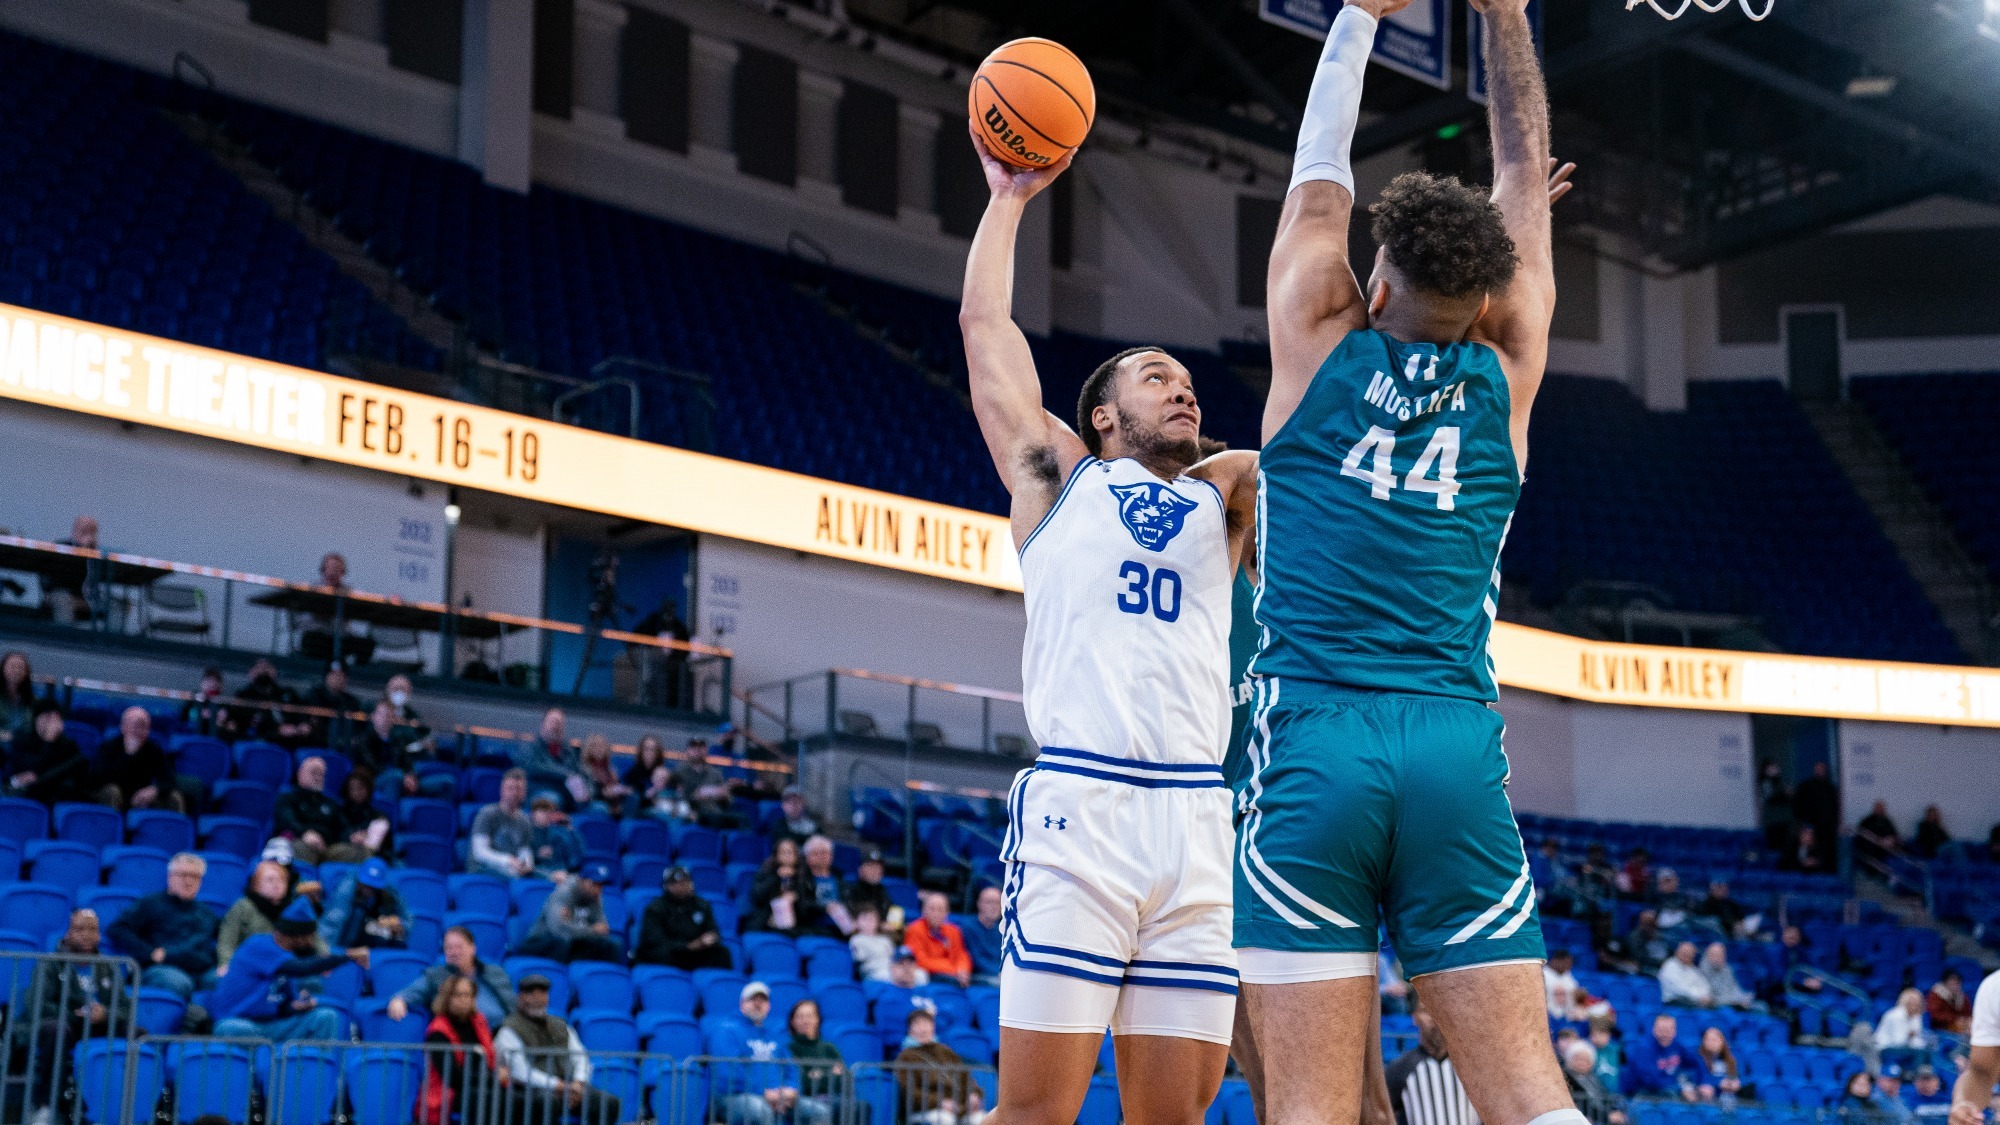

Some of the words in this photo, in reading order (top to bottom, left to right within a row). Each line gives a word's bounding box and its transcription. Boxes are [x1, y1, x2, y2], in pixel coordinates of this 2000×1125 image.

[984, 103, 1052, 165] Wilson
[142, 345, 327, 446] THEATER
[338, 391, 418, 461] FEB.
[1339, 424, 1462, 511] 44
[815, 494, 903, 556] ALVIN
[913, 514, 994, 574] AILEY
[1117, 560, 1182, 623] 30
[1579, 652, 1649, 693] ALVIN
[1659, 660, 1732, 699] AILEY
